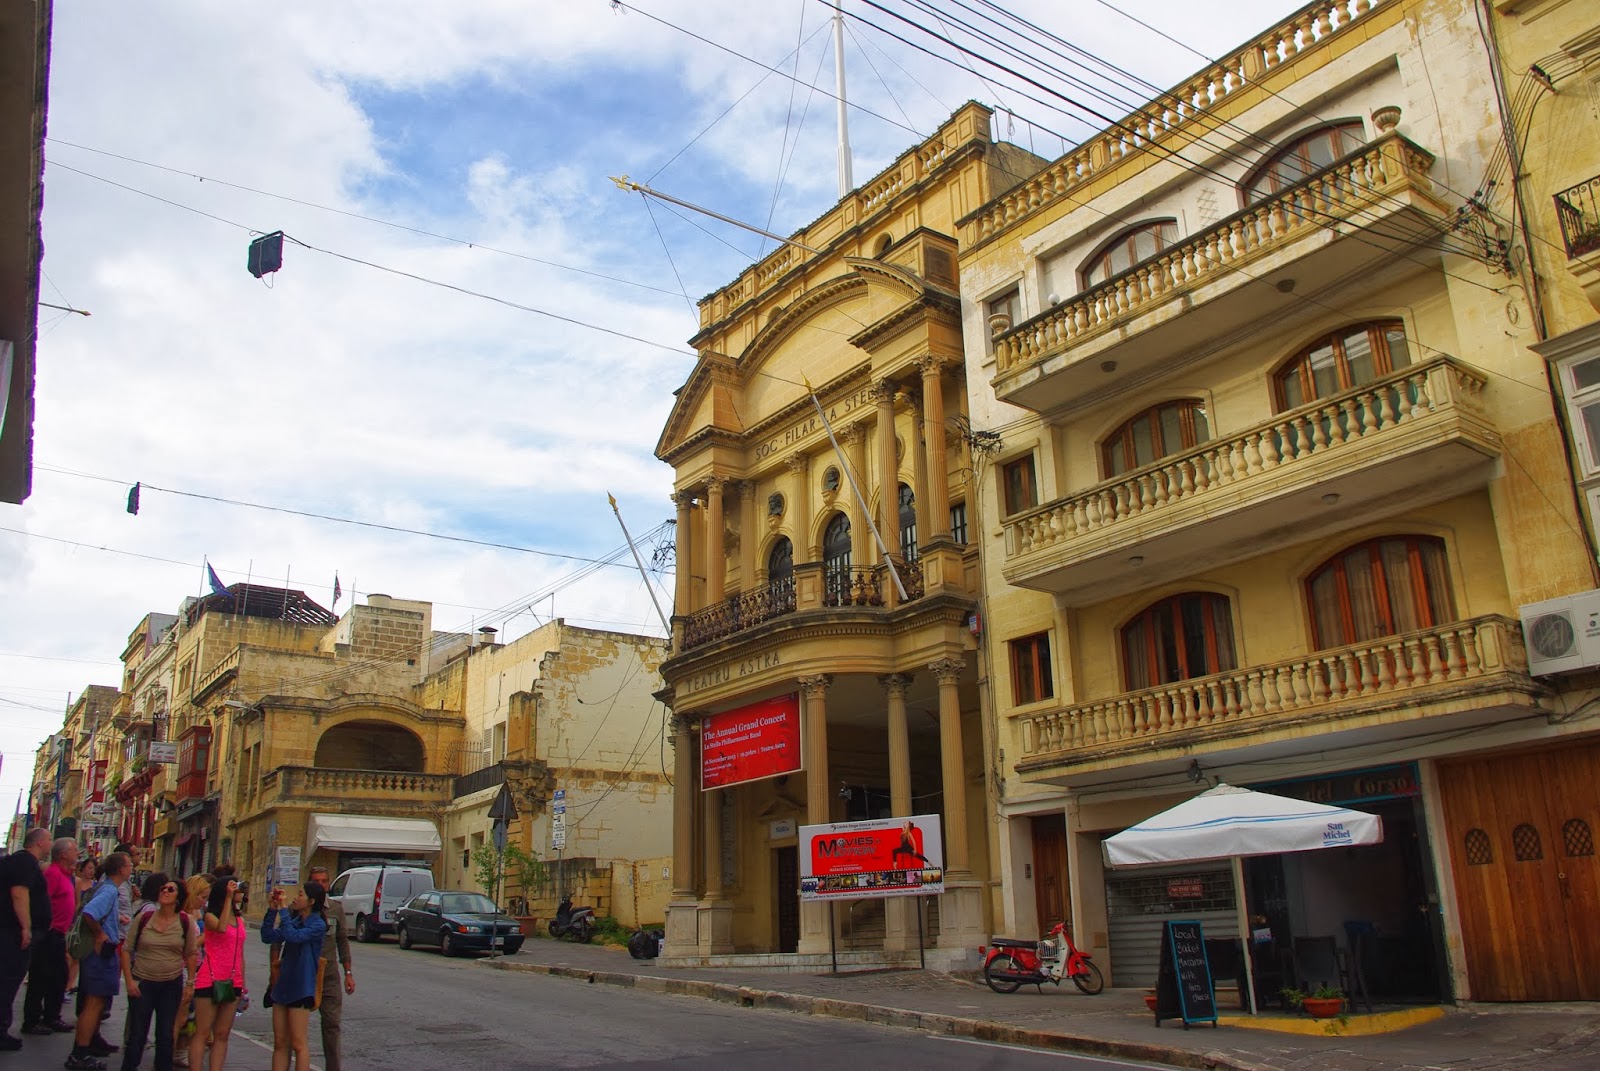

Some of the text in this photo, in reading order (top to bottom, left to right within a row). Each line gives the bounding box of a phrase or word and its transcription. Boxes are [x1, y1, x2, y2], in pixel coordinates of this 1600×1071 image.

[755, 439, 778, 461] SOC
[785, 418, 816, 445] FILAR
[686, 651, 780, 692] TEATRU ASTRA
[704, 712, 786, 741] The Annual Grand Concert
[709, 740, 721, 749] Stella
[721, 733, 750, 746] Philharmonic
[749, 730, 762, 739] Band
[1353, 775, 1408, 796] Corso
[1323, 829, 1351, 840] Michel
[1327, 822, 1344, 831] San
[1173, 925, 1197, 940] Local
